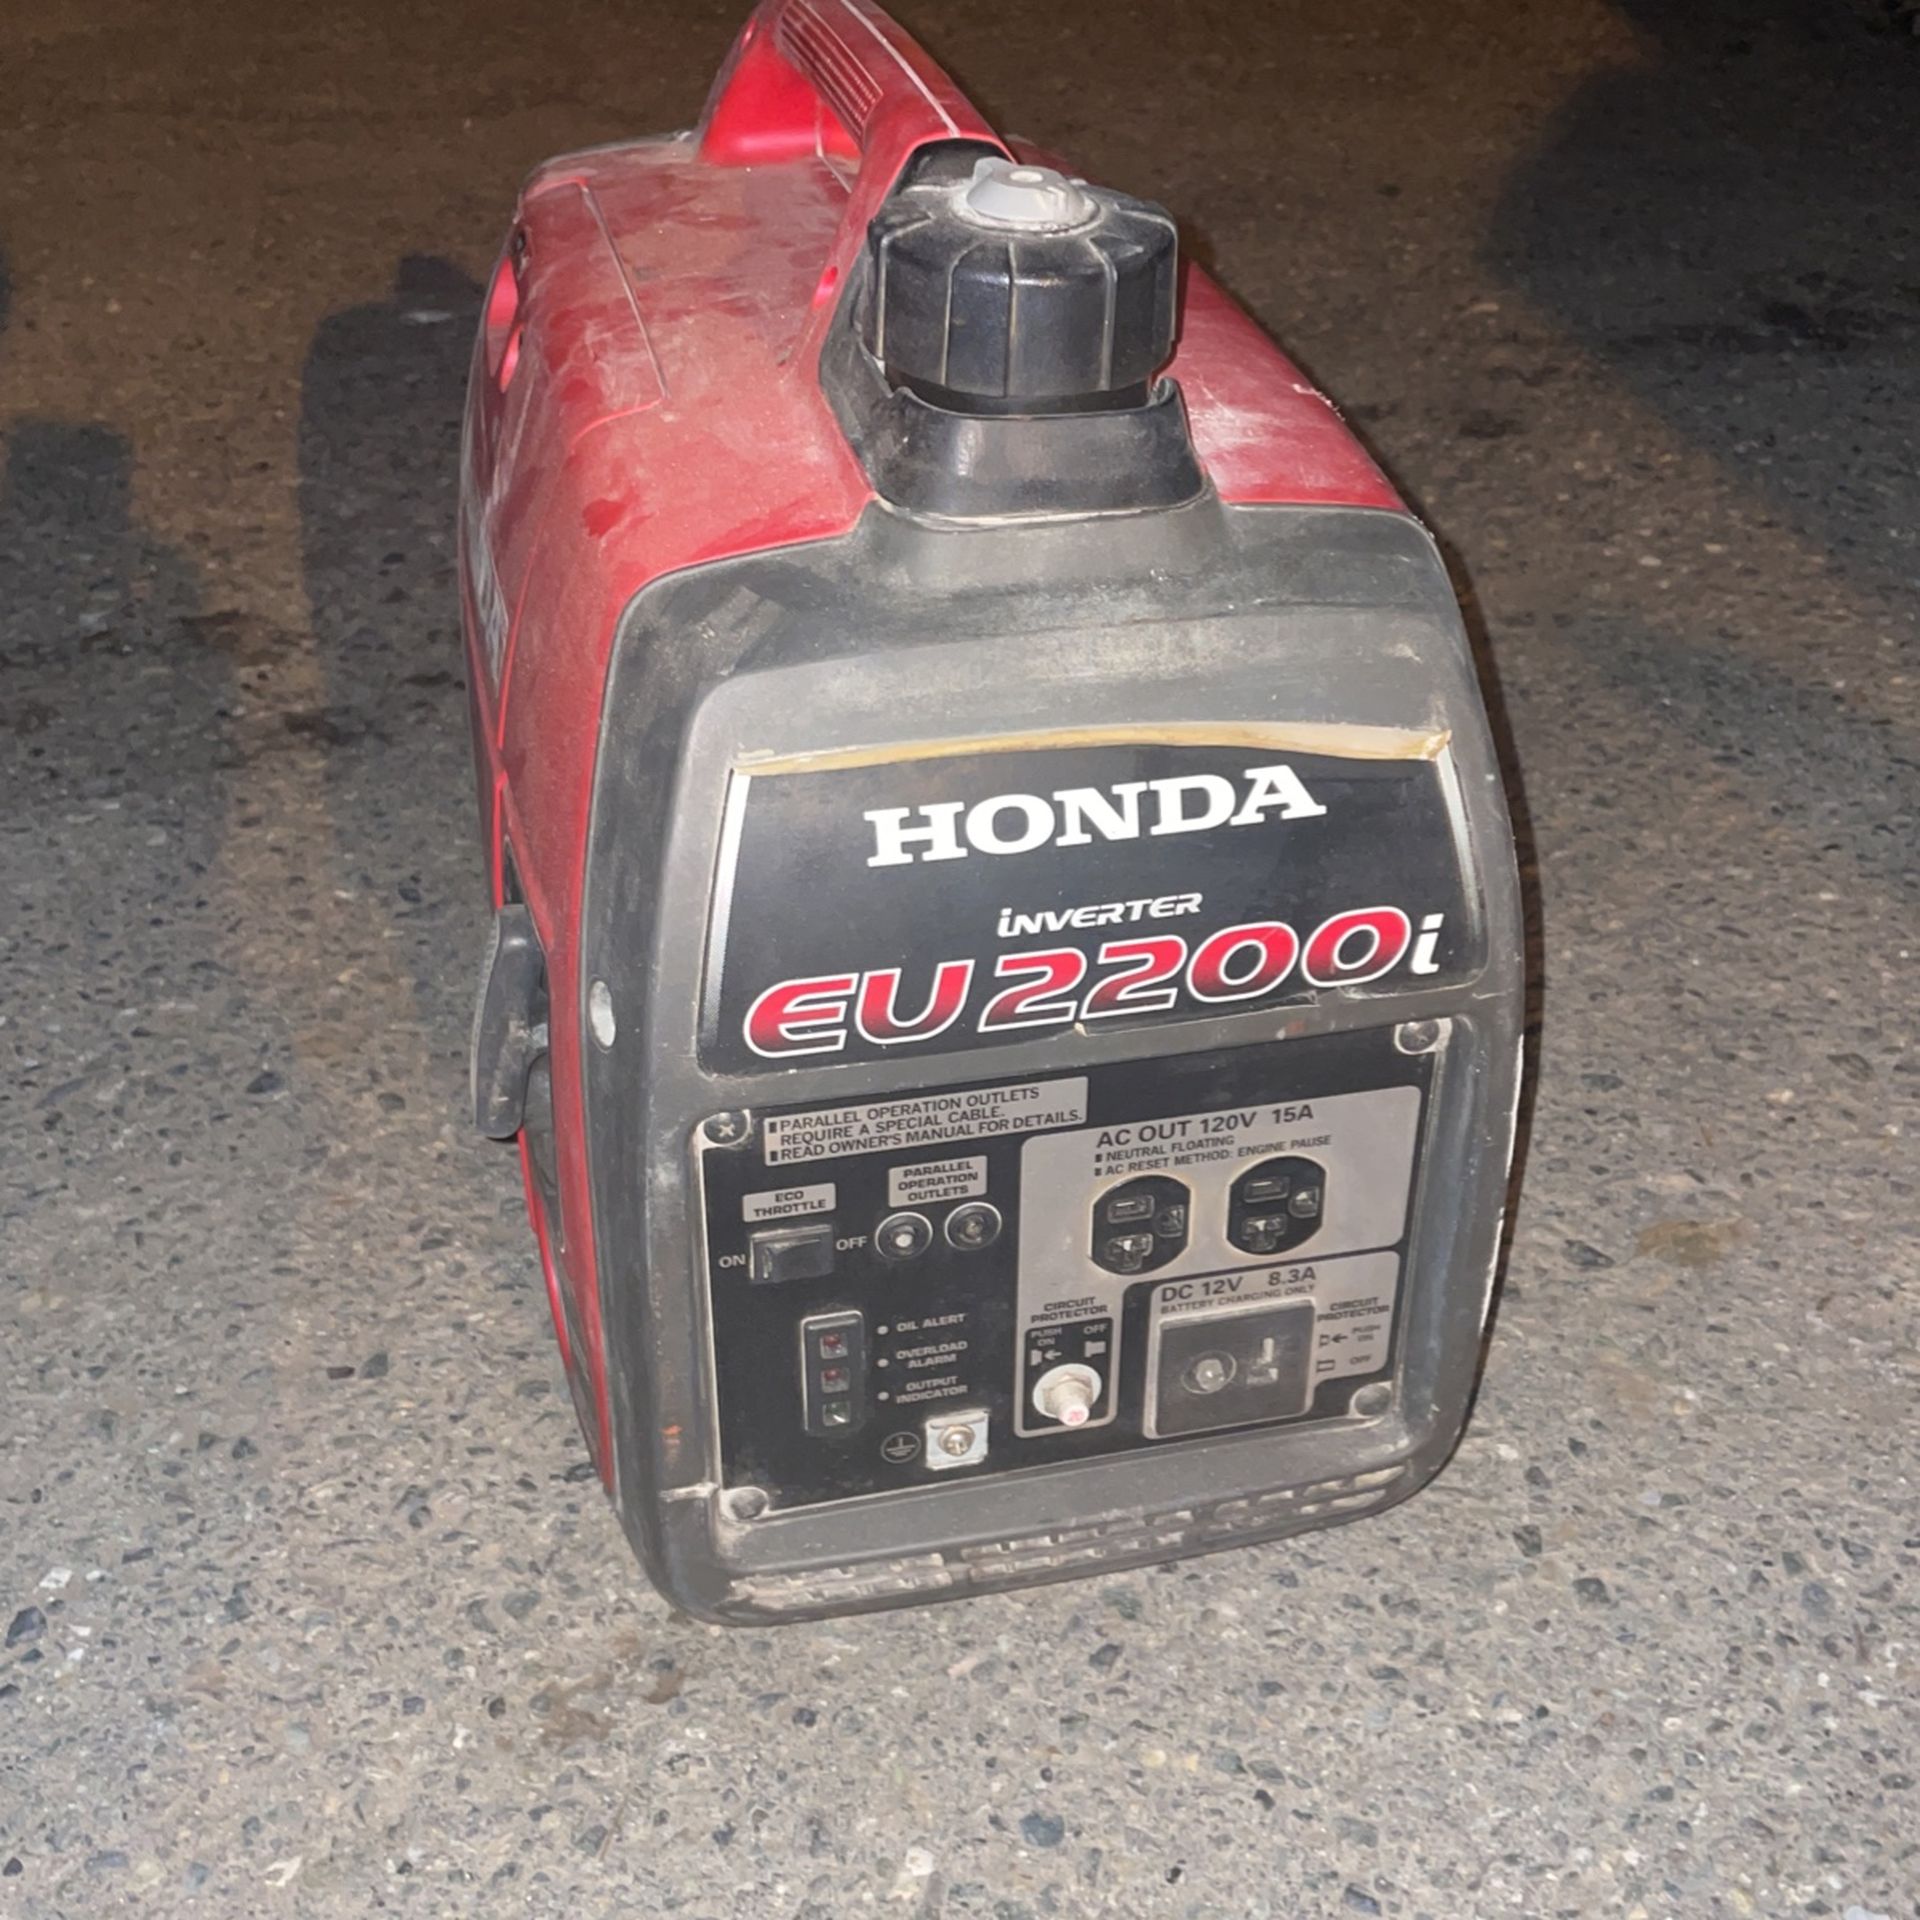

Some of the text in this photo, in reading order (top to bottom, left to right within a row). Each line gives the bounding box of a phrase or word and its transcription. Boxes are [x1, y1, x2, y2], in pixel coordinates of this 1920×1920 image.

[864, 764, 1326, 867] HONDA
[781, 1087, 1040, 1132] PARALLEL OPERATION OUTLETS
[781, 1106, 1005, 1147] REQUIRE A SPECIAL CABLE.
[781, 1109, 1082, 1161] READ OWNER'S MANUAL FOR DETAILS.
[1097, 1105, 1314, 1148] AC OUT 120V 15A
[1105, 1135, 1332, 1177] AC RESET METHOD: ENGINE PAUSE
[1106, 1135, 1235, 1162] NEUTRAL FLOATING
[903, 1161, 973, 1179] PARALLEL
[898, 1172, 979, 1191] OPERATION
[775, 1190, 804, 1203] ECO
[908, 1185, 969, 1202] OUTLETS
[754, 1199, 826, 1217] THROTTLE
[836, 1236, 868, 1251] OFF
[719, 1254, 746, 1269] ON
[1161, 1266, 1316, 1303] DC 12V 8.3A
[1043, 1296, 1096, 1311] CIRCUIT
[1161, 1284, 1315, 1315] BATTERY CHARGING ONLY
[1329, 1297, 1378, 1311] CIRCUIT
[896, 1313, 967, 1332] OIL ALERT
[1031, 1305, 1107, 1323] PROTECTOR
[1317, 1305, 1389, 1322] PROTECTOR
[1083, 1323, 1108, 1335] OFF
[896, 1340, 968, 1360] OVERLOAD
[1037, 1337, 1055, 1347] ON
[908, 1353, 957, 1369] ALARM
[906, 1376, 959, 1391] OUTPUT
[896, 1384, 969, 1404] INDICATOR
